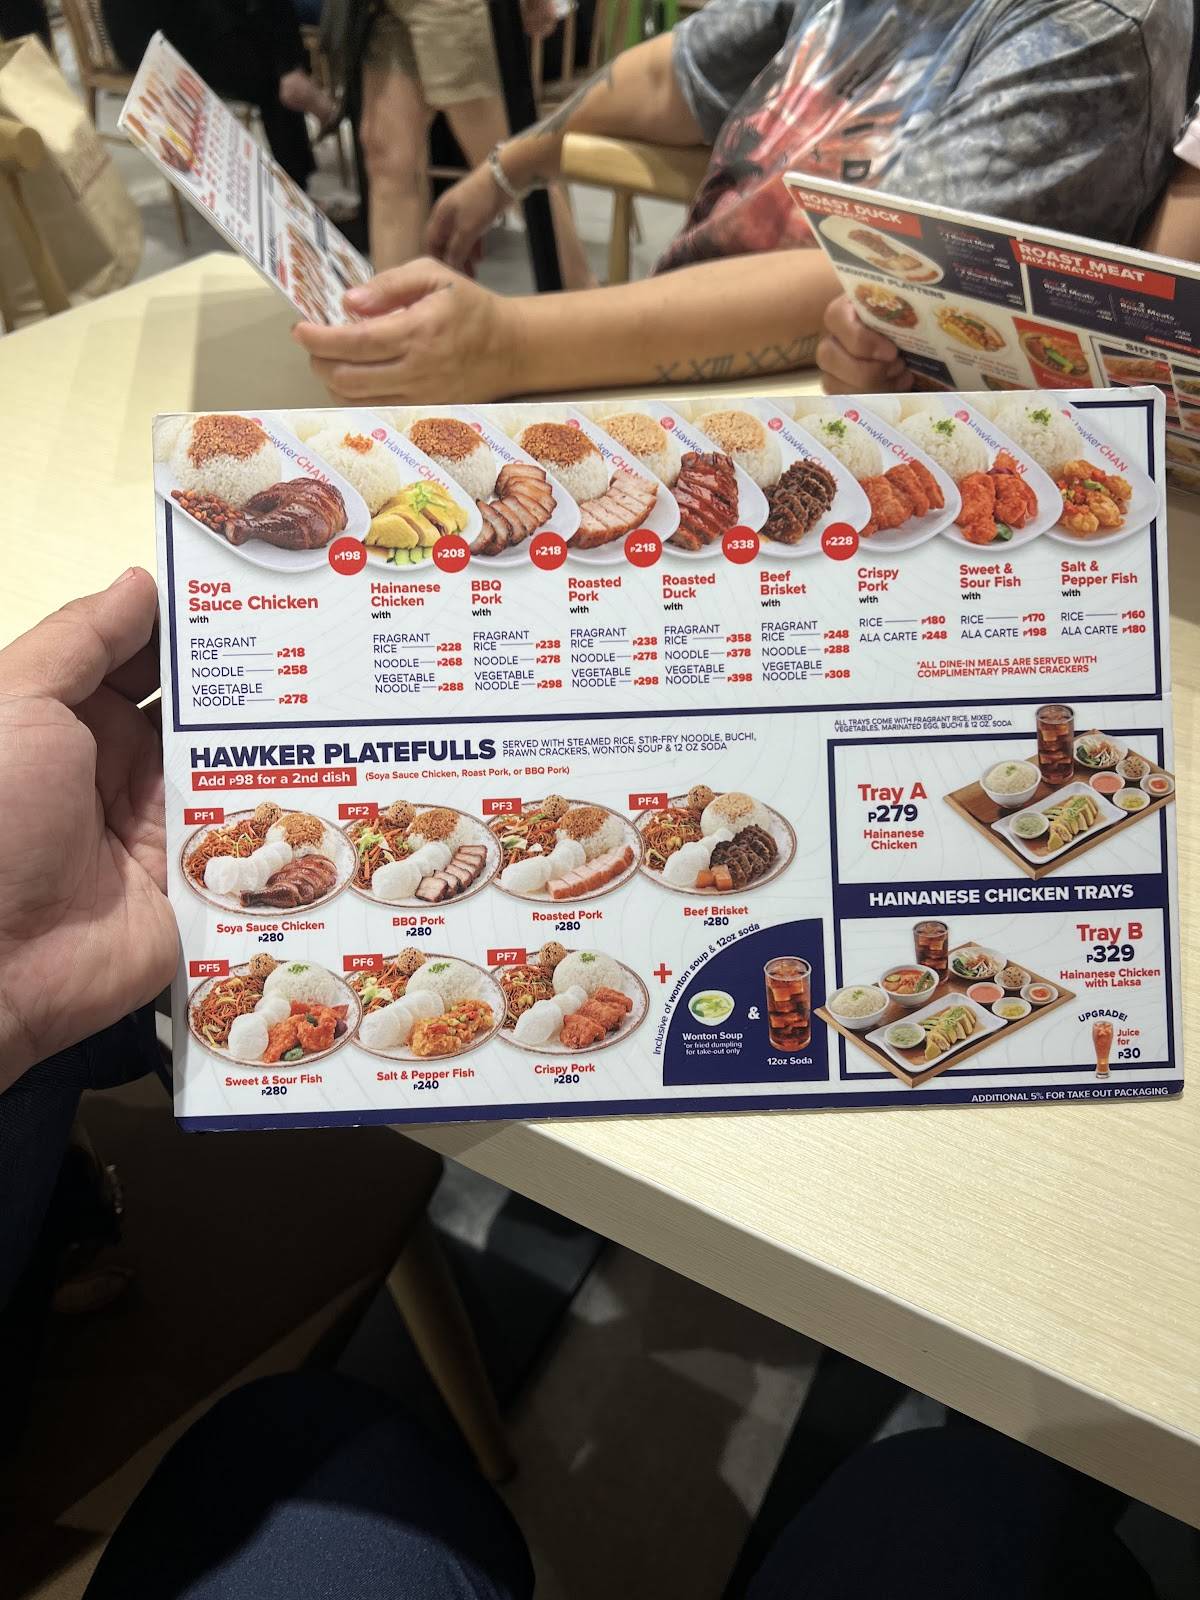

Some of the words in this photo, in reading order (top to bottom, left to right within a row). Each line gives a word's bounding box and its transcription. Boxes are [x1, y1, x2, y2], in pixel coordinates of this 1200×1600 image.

[854, 205, 902, 224] DUCK
[1019, 243, 1082, 266] ROAST
[1088, 261, 1145, 282] MEAT
[1021, 254, 1103, 280] MIX-N-MATCH
[1125, 343, 1168, 360] SIDES
[1061, 562, 1087, 572] Salt
[1090, 561, 1098, 572] &
[662, 573, 716, 585] Roasted
[760, 570, 791, 582] Beef
[857, 567, 899, 581] Crispy
[1061, 574, 1109, 586] Pepper
[1112, 572, 1138, 584] Fish
[189, 580, 231, 595] Soya
[371, 582, 441, 594] Hainanese
[471, 580, 502, 592] BBQ
[568, 576, 622, 588] Roasted
[858, 579, 889, 592] Pork
[663, 587, 697, 598] Duck
[760, 583, 806, 595] Brisket
[1061, 589, 1081, 598] with
[371, 595, 424, 607] Chicken
[471, 593, 502, 605] Pork
[569, 591, 599, 602] Pork
[189, 597, 242, 611] Sauce
[247, 595, 318, 609] Chicken
[189, 615, 209, 624] with
[1061, 611, 1084, 622] RICE
[1061, 626, 1081, 636] ALA
[1085, 625, 1118, 635] CARTE
[190, 636, 257, 649] FRAGRANT
[191, 649, 218, 661] RICE
[939, 658, 976, 668] DINE-IN
[978, 657, 1011, 667] MEALS
[1013, 657, 1031, 666] ARE
[1033, 656, 1069, 665] SERVED
[1072, 655, 1097, 664] WITH
[192, 666, 244, 678] NOODLE
[917, 668, 1000, 678] COMPLIMENTARY
[1002, 667, 1037, 676] PRAWN
[1039, 665, 1089, 675] CRACKERS
[192, 683, 263, 695] VEGETABLE
[193, 695, 246, 707] NOODLE
[848, 718, 870, 726] TRAYS
[913, 715, 951, 723] FRAGRANT
[881, 722, 922, 731] MARINATED
[940, 721, 963, 729] BUCHI
[992, 719, 1012, 727] SODA
[502, 739, 539, 749] SERVED
[541, 739, 565, 748] WITH
[567, 737, 612, 747] STEAMED
[613, 736, 636, 746] RICE,
[639, 734, 678, 745] STIR-FRY
[680, 733, 723, 743] NOODLE,
[725, 732, 756, 742] BUCHI,
[191, 744, 317, 768] HAWKER
[324, 739, 496, 764] PLATEFULLS
[503, 748, 537, 757] PRAWN
[539, 746, 590, 756] CRACKERS,
[592, 745, 635, 754] WONTON
[637, 744, 663, 753] SOUP
[665, 743, 672, 752] &
[674, 743, 683, 752] 12
[685, 743, 699, 751] OZ
[701, 742, 727, 751] SODA
[199, 775, 226, 787] Add
[258, 773, 276, 784] for
[280, 775, 288, 784] a
[293, 772, 319, 783] 2nd
[322, 771, 350, 783] dish
[365, 771, 389, 781] (Soya
[391, 771, 419, 779] Sauce
[421, 770, 459, 779] Chicken,
[462, 768, 487, 777] Roast
[489, 768, 510, 778] Pork,
[525, 766, 545, 775] BBQ
[547, 766, 570, 775] Pork)
[858, 784, 906, 803] Tray
[910, 782, 928, 800] A
[348, 806, 369, 816] PF2
[491, 801, 513, 811] PF3
[194, 812, 215, 821] PF1
[869, 890, 980, 906] HAINANESE
[984, 886, 1070, 903] CHICKEN
[1073, 884, 1134, 900] TRAYS
[738, 922, 760, 938] soda
[1076, 924, 1122, 943] Tray
[1128, 923, 1143, 940] B
[716, 932, 737, 948] 12oz
[708, 944, 717, 954] &
[353, 958, 374, 967] PF6
[496, 952, 517, 962] PF7
[689, 951, 709, 971] soup
[199, 964, 220, 973] PF5
[1060, 969, 1116, 979] Hainanese
[1119, 967, 1161, 977] Chicken
[668, 969, 692, 1003] wonton
[1085, 978, 1108, 988] with
[1111, 978, 1141, 987] Laksa
[665, 1002, 673, 1014] of
[1078, 1010, 1128, 1022] UPGRADE!
[653, 1014, 669, 1056] Inclusive
[682, 1032, 718, 1041] Wonton
[719, 1031, 743, 1041] Soup
[1117, 1028, 1140, 1037] Juice
[694, 1041, 710, 1049] fried
[711, 1041, 743, 1049] dumpling
[1117, 1037, 1130, 1046] for
[685, 1048, 695, 1056] for
[697, 1047, 725, 1055] take-out
[726, 1047, 741, 1056] only
[767, 1057, 788, 1065] 12oz
[790, 1056, 813, 1065] Soda
[377, 1071, 397, 1081] Salt
[399, 1071, 408, 1080] &
[411, 1069, 449, 1082] Pepper
[452, 1068, 474, 1078] Fish
[972, 1092, 1028, 1102] ADDITIONAL
[1030, 1091, 1044, 1100] 5%
[1046, 1091, 1065, 1099] FOR
[1067, 1090, 1090, 1099] TAKE
[1092, 1089, 1113, 1098] OUT
[1115, 1087, 1168, 1097] PACKAGING
